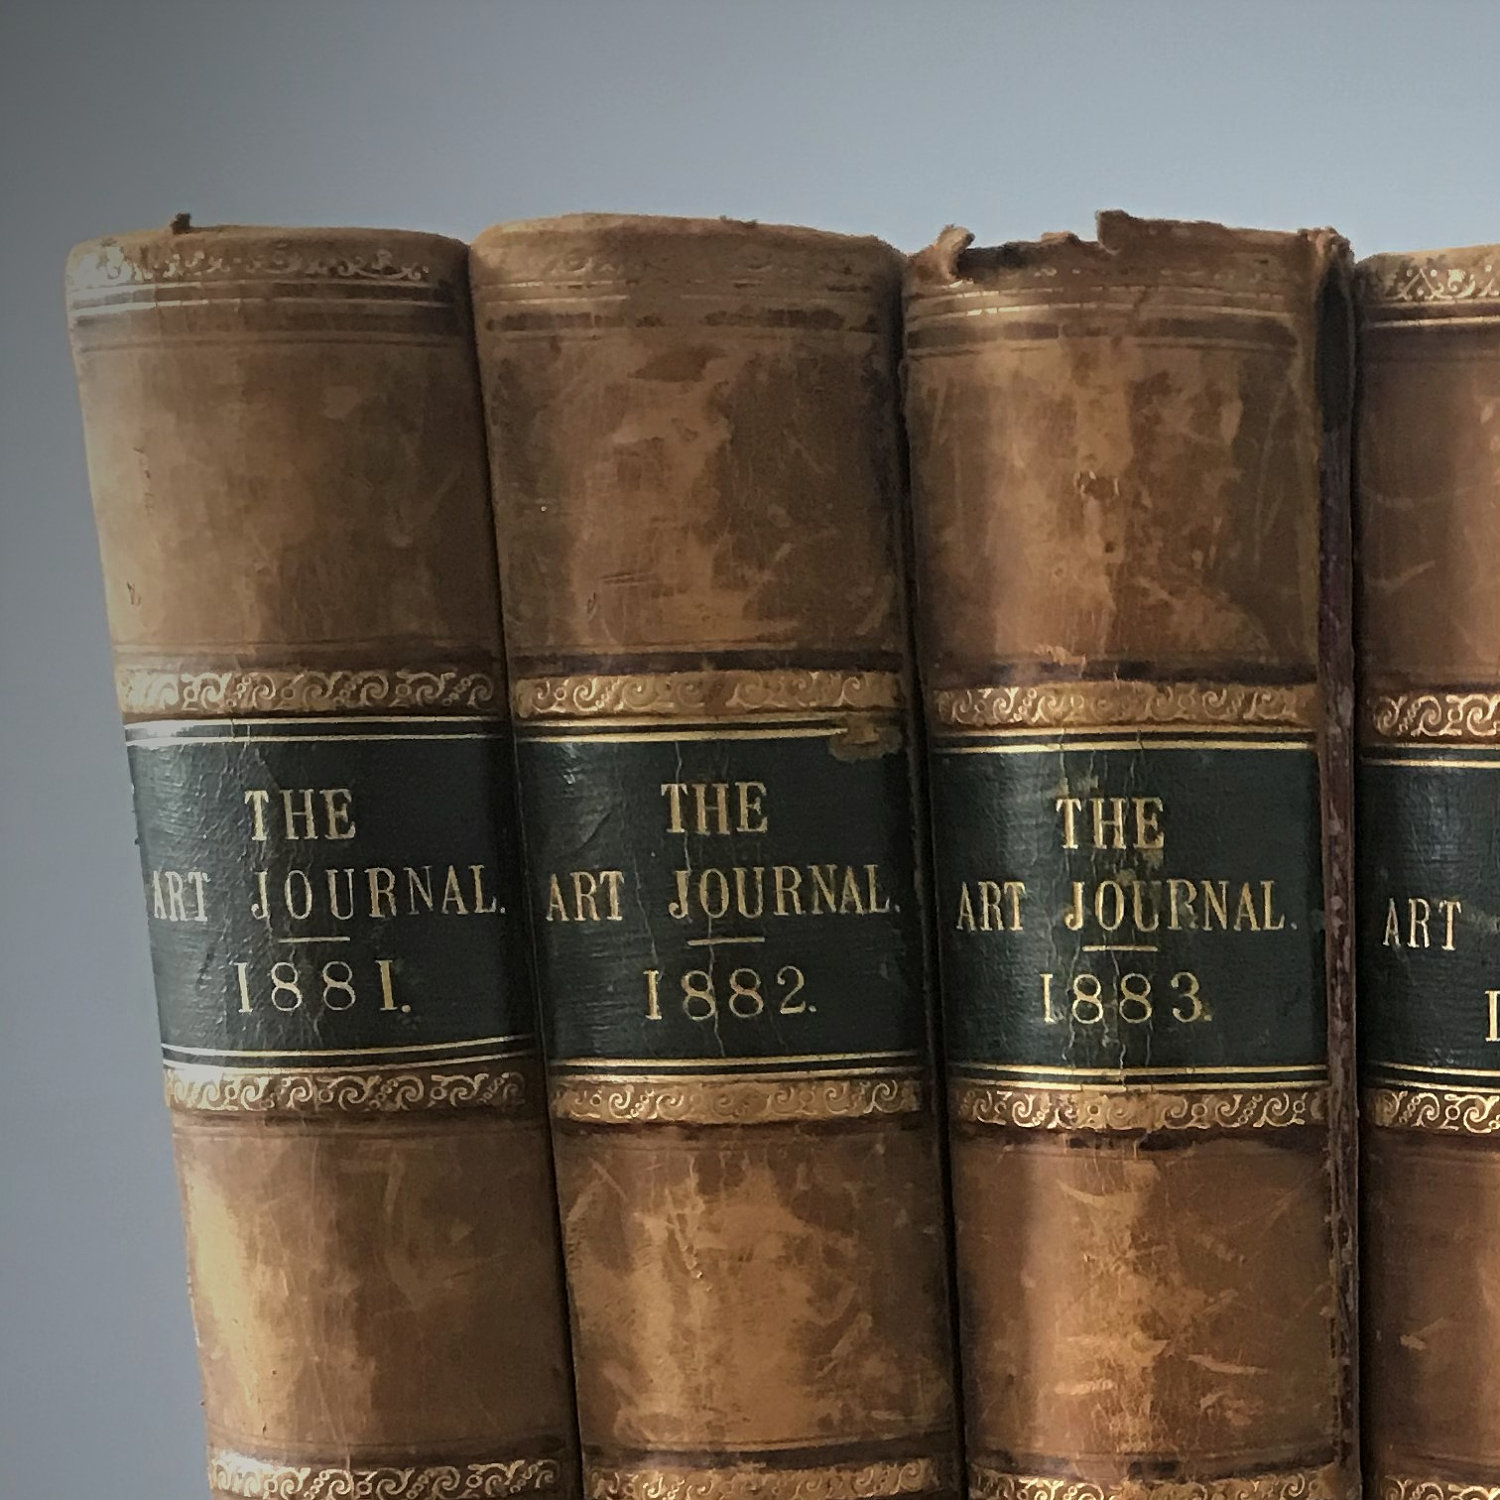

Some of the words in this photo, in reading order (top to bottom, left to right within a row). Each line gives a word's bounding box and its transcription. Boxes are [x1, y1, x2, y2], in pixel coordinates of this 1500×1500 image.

[243, 788, 356, 842] THE
[660, 781, 768, 835] THE
[1055, 796, 1165, 851] THE
[150, 869, 212, 922] ART
[250, 864, 506, 920] JOURNAL.
[545, 870, 625, 922] ART
[667, 863, 901, 920] JOURNAL.
[955, 880, 1026, 932] ART
[1063, 878, 1298, 932] JOURNAL.
[1382, 897, 1463, 951] ART
[233, 959, 412, 1014] 1881.
[643, 965, 818, 1021] 1882.
[1039, 971, 1213, 1025] 1883.
